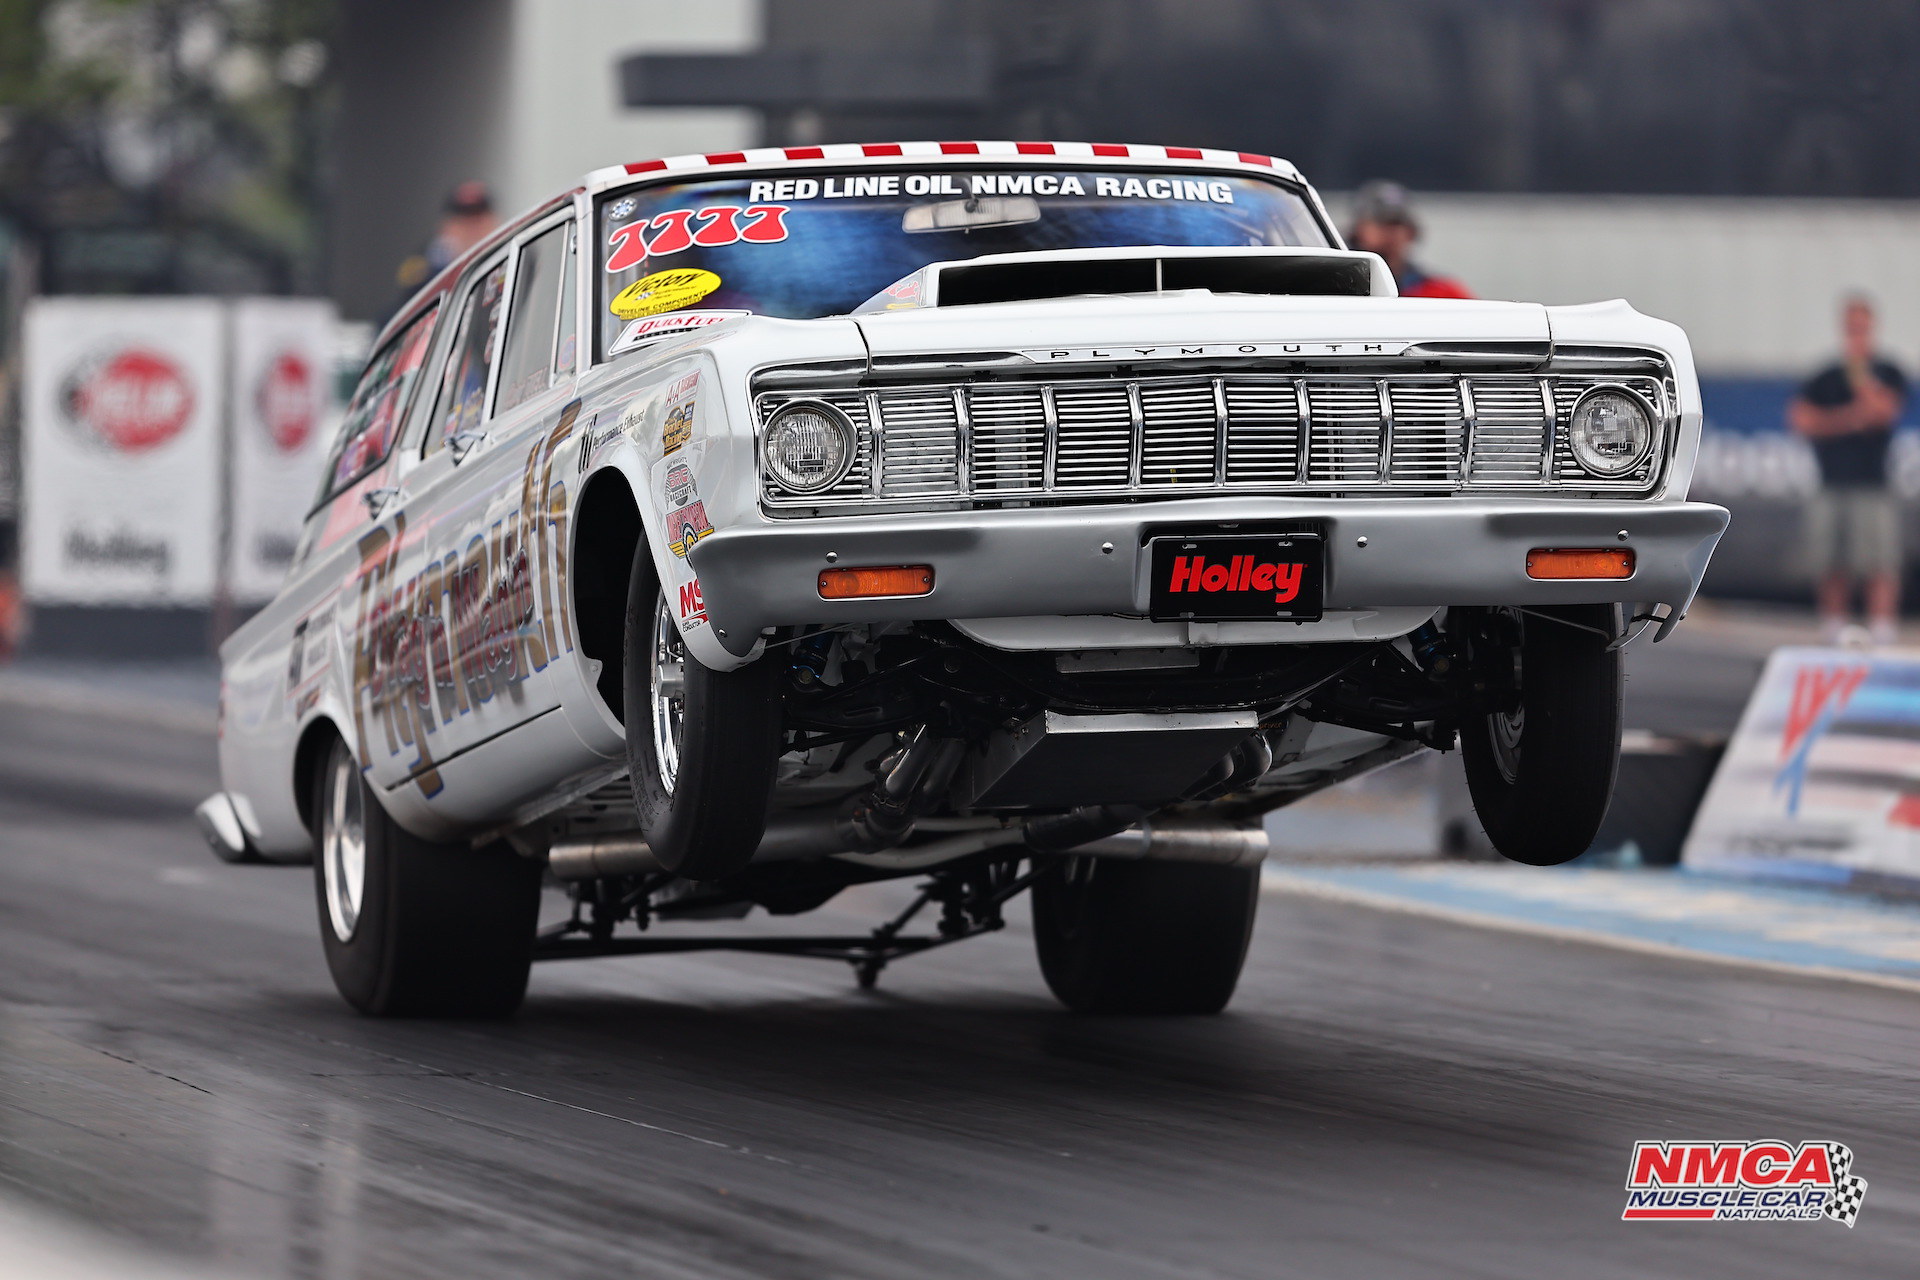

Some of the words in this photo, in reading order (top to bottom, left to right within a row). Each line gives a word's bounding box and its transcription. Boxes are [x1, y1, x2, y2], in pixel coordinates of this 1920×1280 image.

[749, 180, 819, 203] RED
[823, 177, 900, 197] LINE
[904, 176, 963, 195] OIL
[971, 176, 1086, 196] NMCA
[1095, 177, 1234, 204] RACING
[606, 205, 790, 273] 7777
[623, 271, 707, 299] Victory
[1050, 343, 1383, 359] PLYMOUTH
[1169, 555, 1303, 604] Holley
